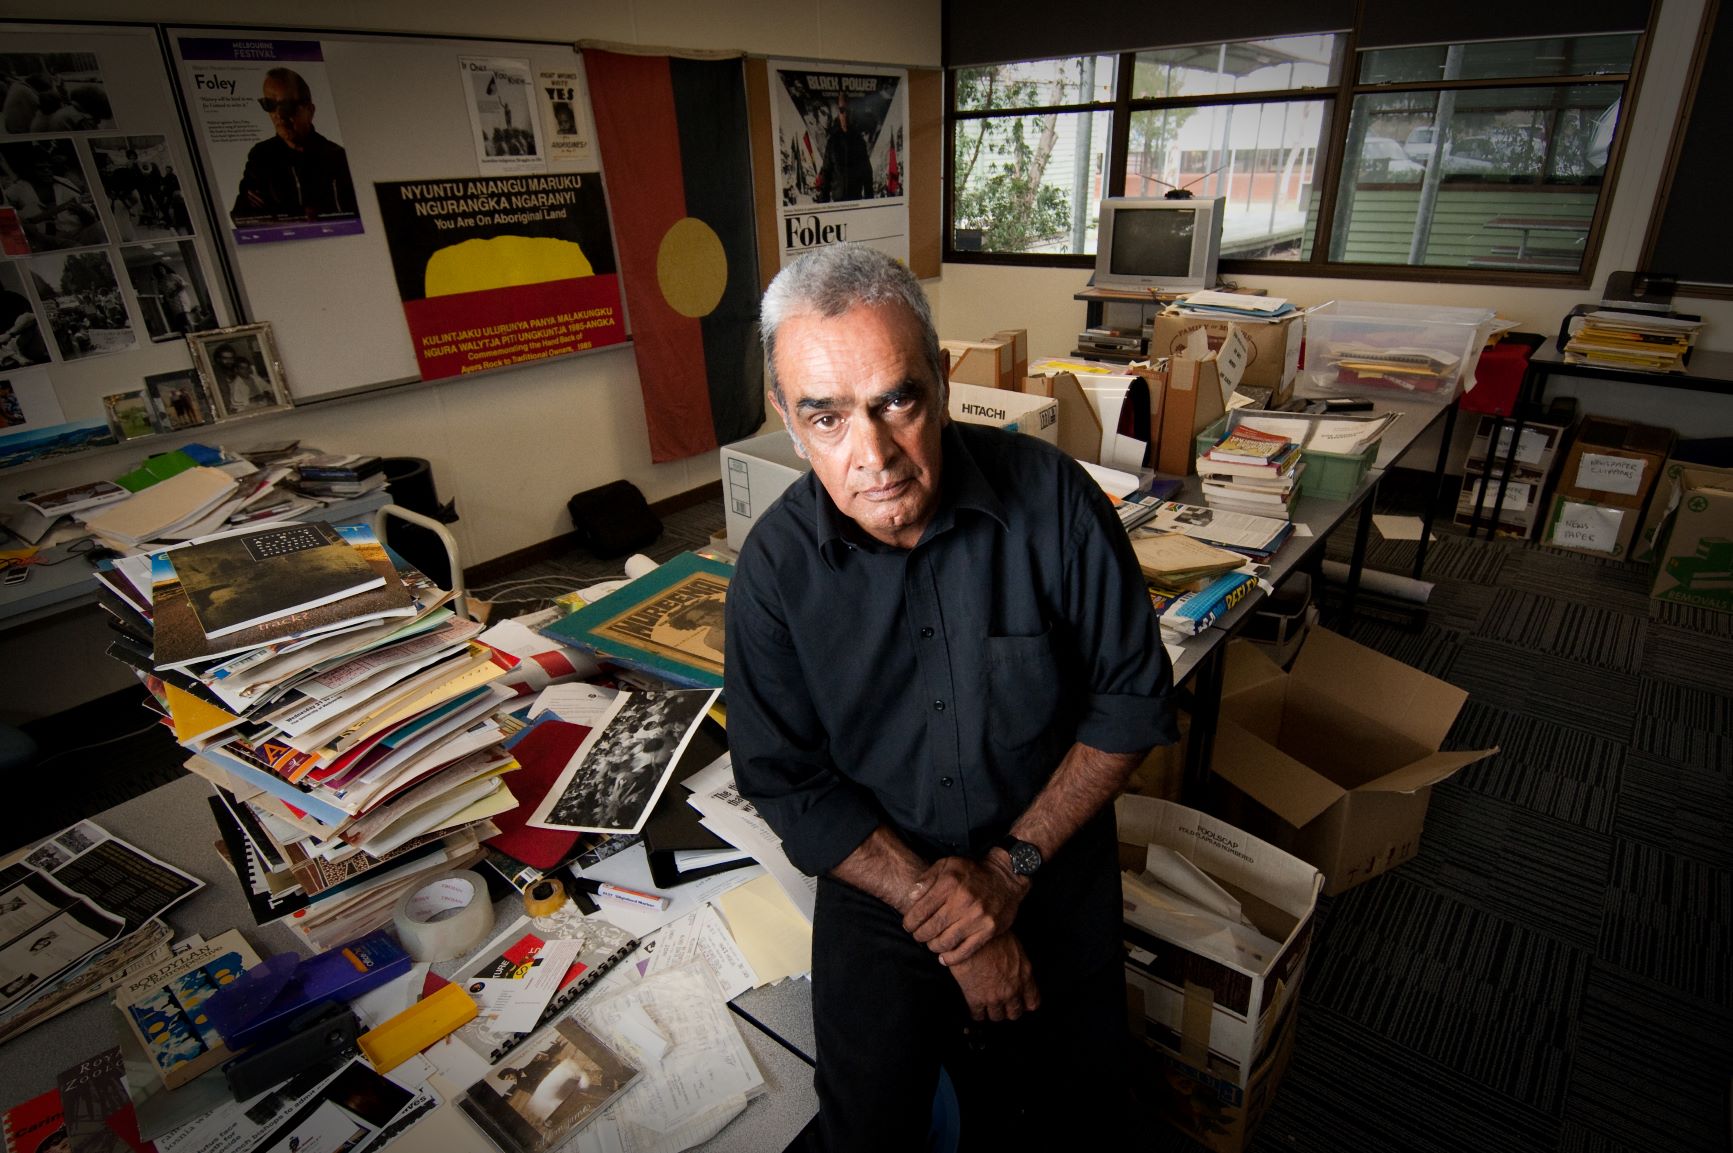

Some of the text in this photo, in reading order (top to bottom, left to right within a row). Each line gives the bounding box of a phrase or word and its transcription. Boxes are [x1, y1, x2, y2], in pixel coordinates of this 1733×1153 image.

[234, 49, 277, 58] FESTIVAL
[194, 74, 236, 95] Foley
[806, 75, 877, 91] BLACK POWER
[545, 87, 574, 101] YES
[400, 182, 464, 200] NYUNTU
[528, 175, 582, 192] MARUKU
[415, 191, 577, 217] NGURANGKA NGARANYI
[433, 207, 567, 230] You Are On Aboriginal Land
[422, 326, 482, 347] KULINTJAKU
[467, 343, 529, 361] Commemorating
[529, 340, 541, 350] the
[542, 337, 559, 348] Hand
[574, 333, 583, 341] of
[424, 344, 458, 359] NGURA
[461, 363, 482, 376] Ayers
[483, 360, 503, 371] Rock
[503, 358, 512, 366] to
[512, 351, 549, 364] Traditional
[961, 403, 1006, 420] HITACHI
[1564, 530, 1596, 542] PAPER
[1668, 591, 1728, 610] REMOVALS
[1178, 826, 1195, 836] FOLD
[1197, 825, 1239, 849] FOOLSCAP
[128, 973, 158, 992] BOB
[159, 944, 211, 973] DYLAN
